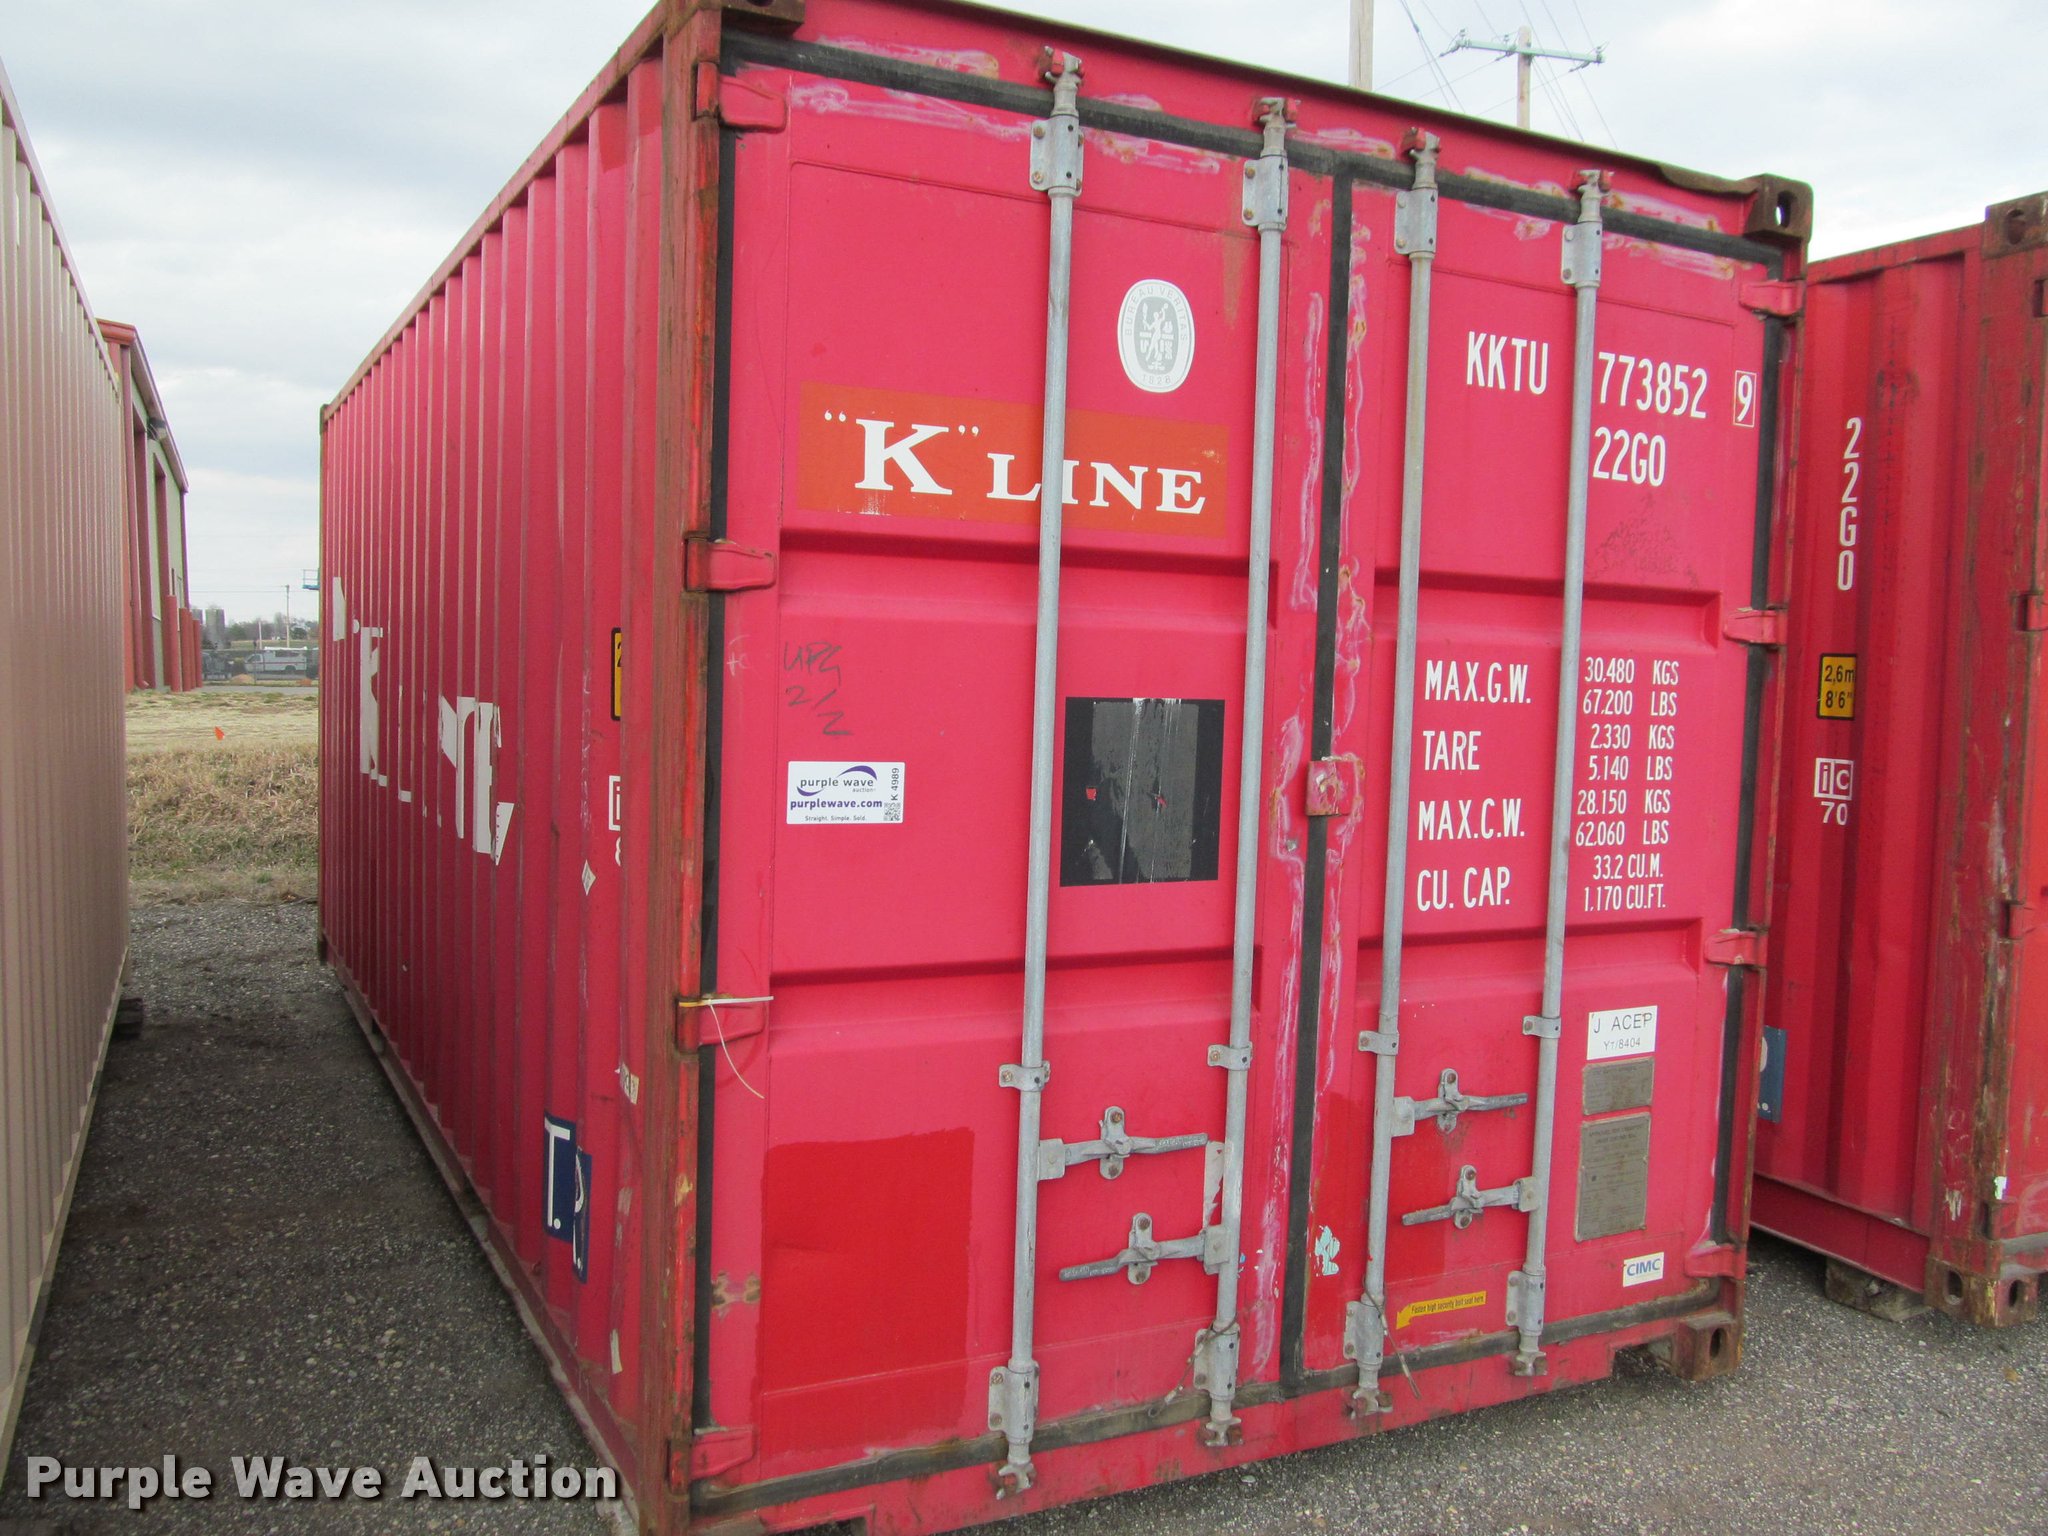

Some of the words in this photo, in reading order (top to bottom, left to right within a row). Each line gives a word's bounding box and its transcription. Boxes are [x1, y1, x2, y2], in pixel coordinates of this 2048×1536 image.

[1124, 286, 1155, 337] BUREAU
[1159, 286, 1188, 342] VERITAS
[1466, 330, 1549, 395] KKTU
[1598, 351, 1708, 419] 773852
[1736, 374, 1753, 423] 9
[987, 452, 1207, 515] LINE
[1424, 659, 1532, 704] MAX.G.W.
[1584, 656, 1635, 684] 30,480
[1652, 659, 1680, 685] KGS
[1583, 689, 1633, 715] 67,200
[1650, 691, 1677, 716] LBS
[1590, 723, 1631, 750] 2,330
[1648, 724, 1675, 750] KGS
[1422, 730, 1482, 771] TARE
[891, 768, 900, 791] 4989
[1588, 755, 1629, 781] 5,140
[1646, 756, 1673, 780] LBS
[800, 777, 839, 788] purple
[843, 779, 874, 787] wave
[790, 798, 883, 811] purplewave.com
[890, 793, 899, 801] K
[1577, 789, 1627, 815] 28,150
[1644, 789, 1671, 814] KGS
[1418, 797, 1526, 841] MAX.C.W.
[1820, 801, 1848, 826] 70
[1575, 821, 1625, 847] 62,060
[1642, 820, 1670, 845] LBS
[1593, 854, 1623, 880] 33.2
[1627, 853, 1664, 878] CU.M.
[1416, 869, 1454, 912] CU.
[1463, 866, 1511, 908] CAP.
[1584, 886, 1621, 912] 1,170
[1626, 884, 1666, 909] CU.FT.
[1611, 1012, 1653, 1031] ACEP
[1626, 1258, 1661, 1278] CIMC
